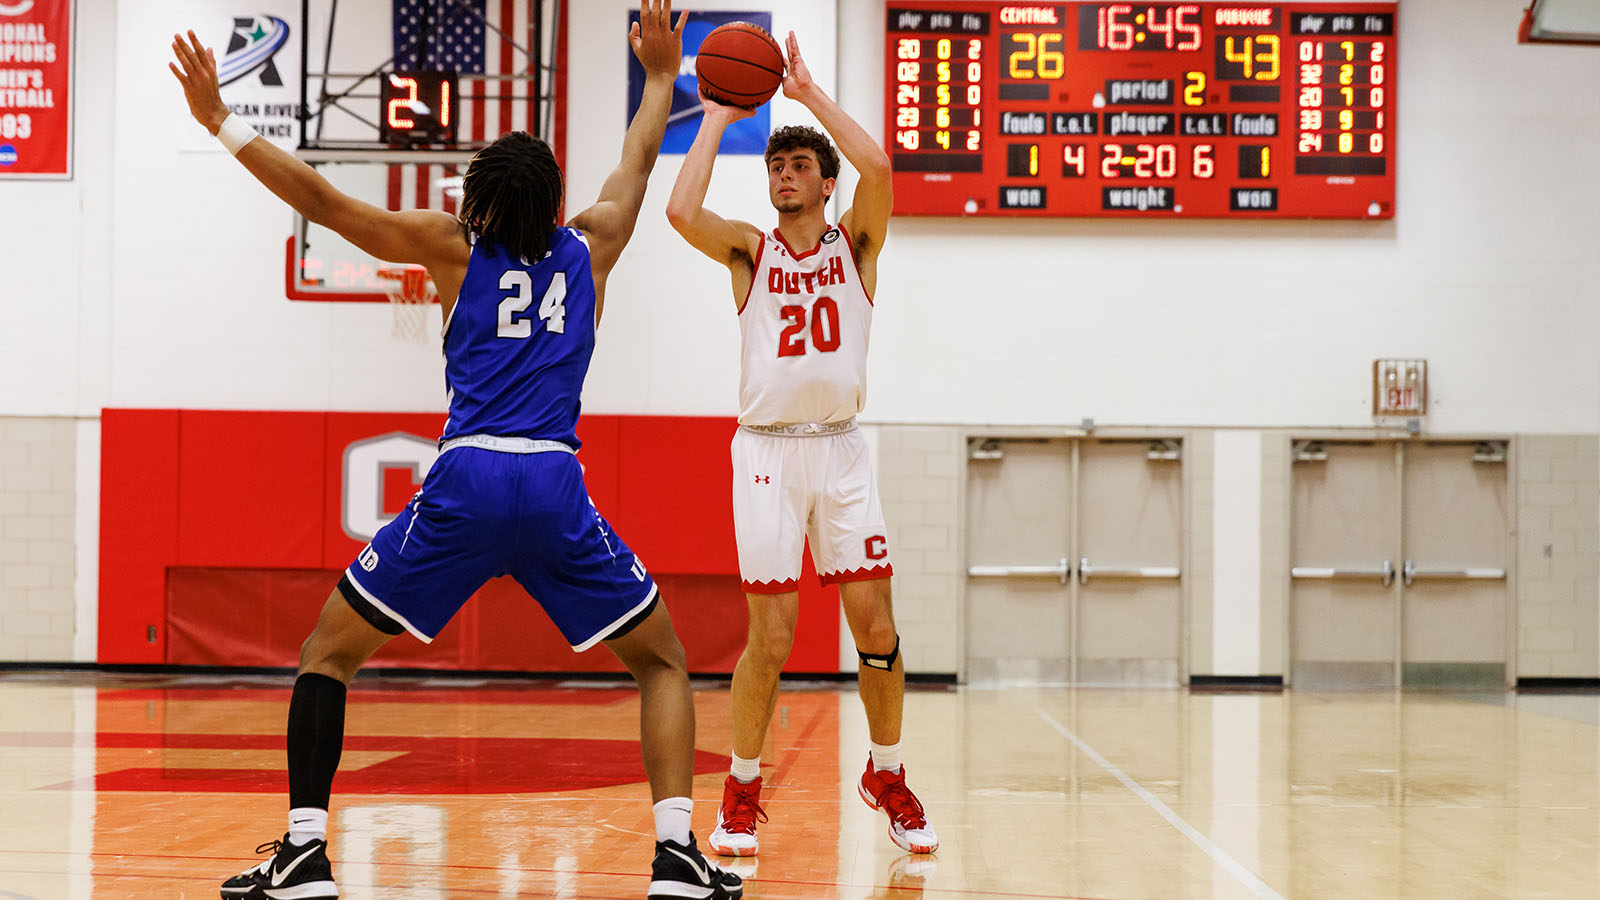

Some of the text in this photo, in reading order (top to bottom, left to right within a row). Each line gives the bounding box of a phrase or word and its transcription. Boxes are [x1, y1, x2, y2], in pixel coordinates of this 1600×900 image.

[1000, 6, 1059, 25] CENTRAL
[1097, 5, 1202, 51] 16:45
[897, 38, 982, 60] 20 0 2
[1009, 32, 1065, 79] 26
[1225, 35, 1281, 81] 43
[1299, 41, 1323, 62] 01
[1370, 41, 1385, 63] 2
[897, 61, 981, 83] 02 5 0
[1339, 64, 1354, 85] 2
[1370, 64, 1385, 85] 0
[897, 84, 981, 106] 24 5 0
[1111, 79, 1169, 104] period
[1184, 71, 1206, 106] 2
[1299, 86, 1323, 107] 20
[1369, 86, 1384, 108] 0
[388, 75, 450, 129] 21
[973, 108, 981, 127] 1
[1003, 112, 1045, 134] fouls
[1111, 111, 1168, 136] player
[1234, 116, 1276, 135] fouls
[1339, 109, 1354, 131] 9
[1376, 110, 1385, 130] 1
[896, 129, 981, 151] 40 4 2
[1299, 132, 1323, 153] 24
[1369, 132, 1384, 153] 0
[1029, 144, 1039, 176] 1
[1063, 145, 1086, 176] 4
[1101, 144, 1177, 178] 2-20
[1192, 144, 1214, 178] 6
[1260, 146, 1270, 177] 1
[1006, 188, 1042, 206] won
[1109, 186, 1167, 212] weight
[1237, 190, 1272, 208] won
[767, 255, 846, 295] DUTCH
[496, 269, 568, 340] 24
[777, 296, 842, 358] 20
[864, 534, 889, 561] C
